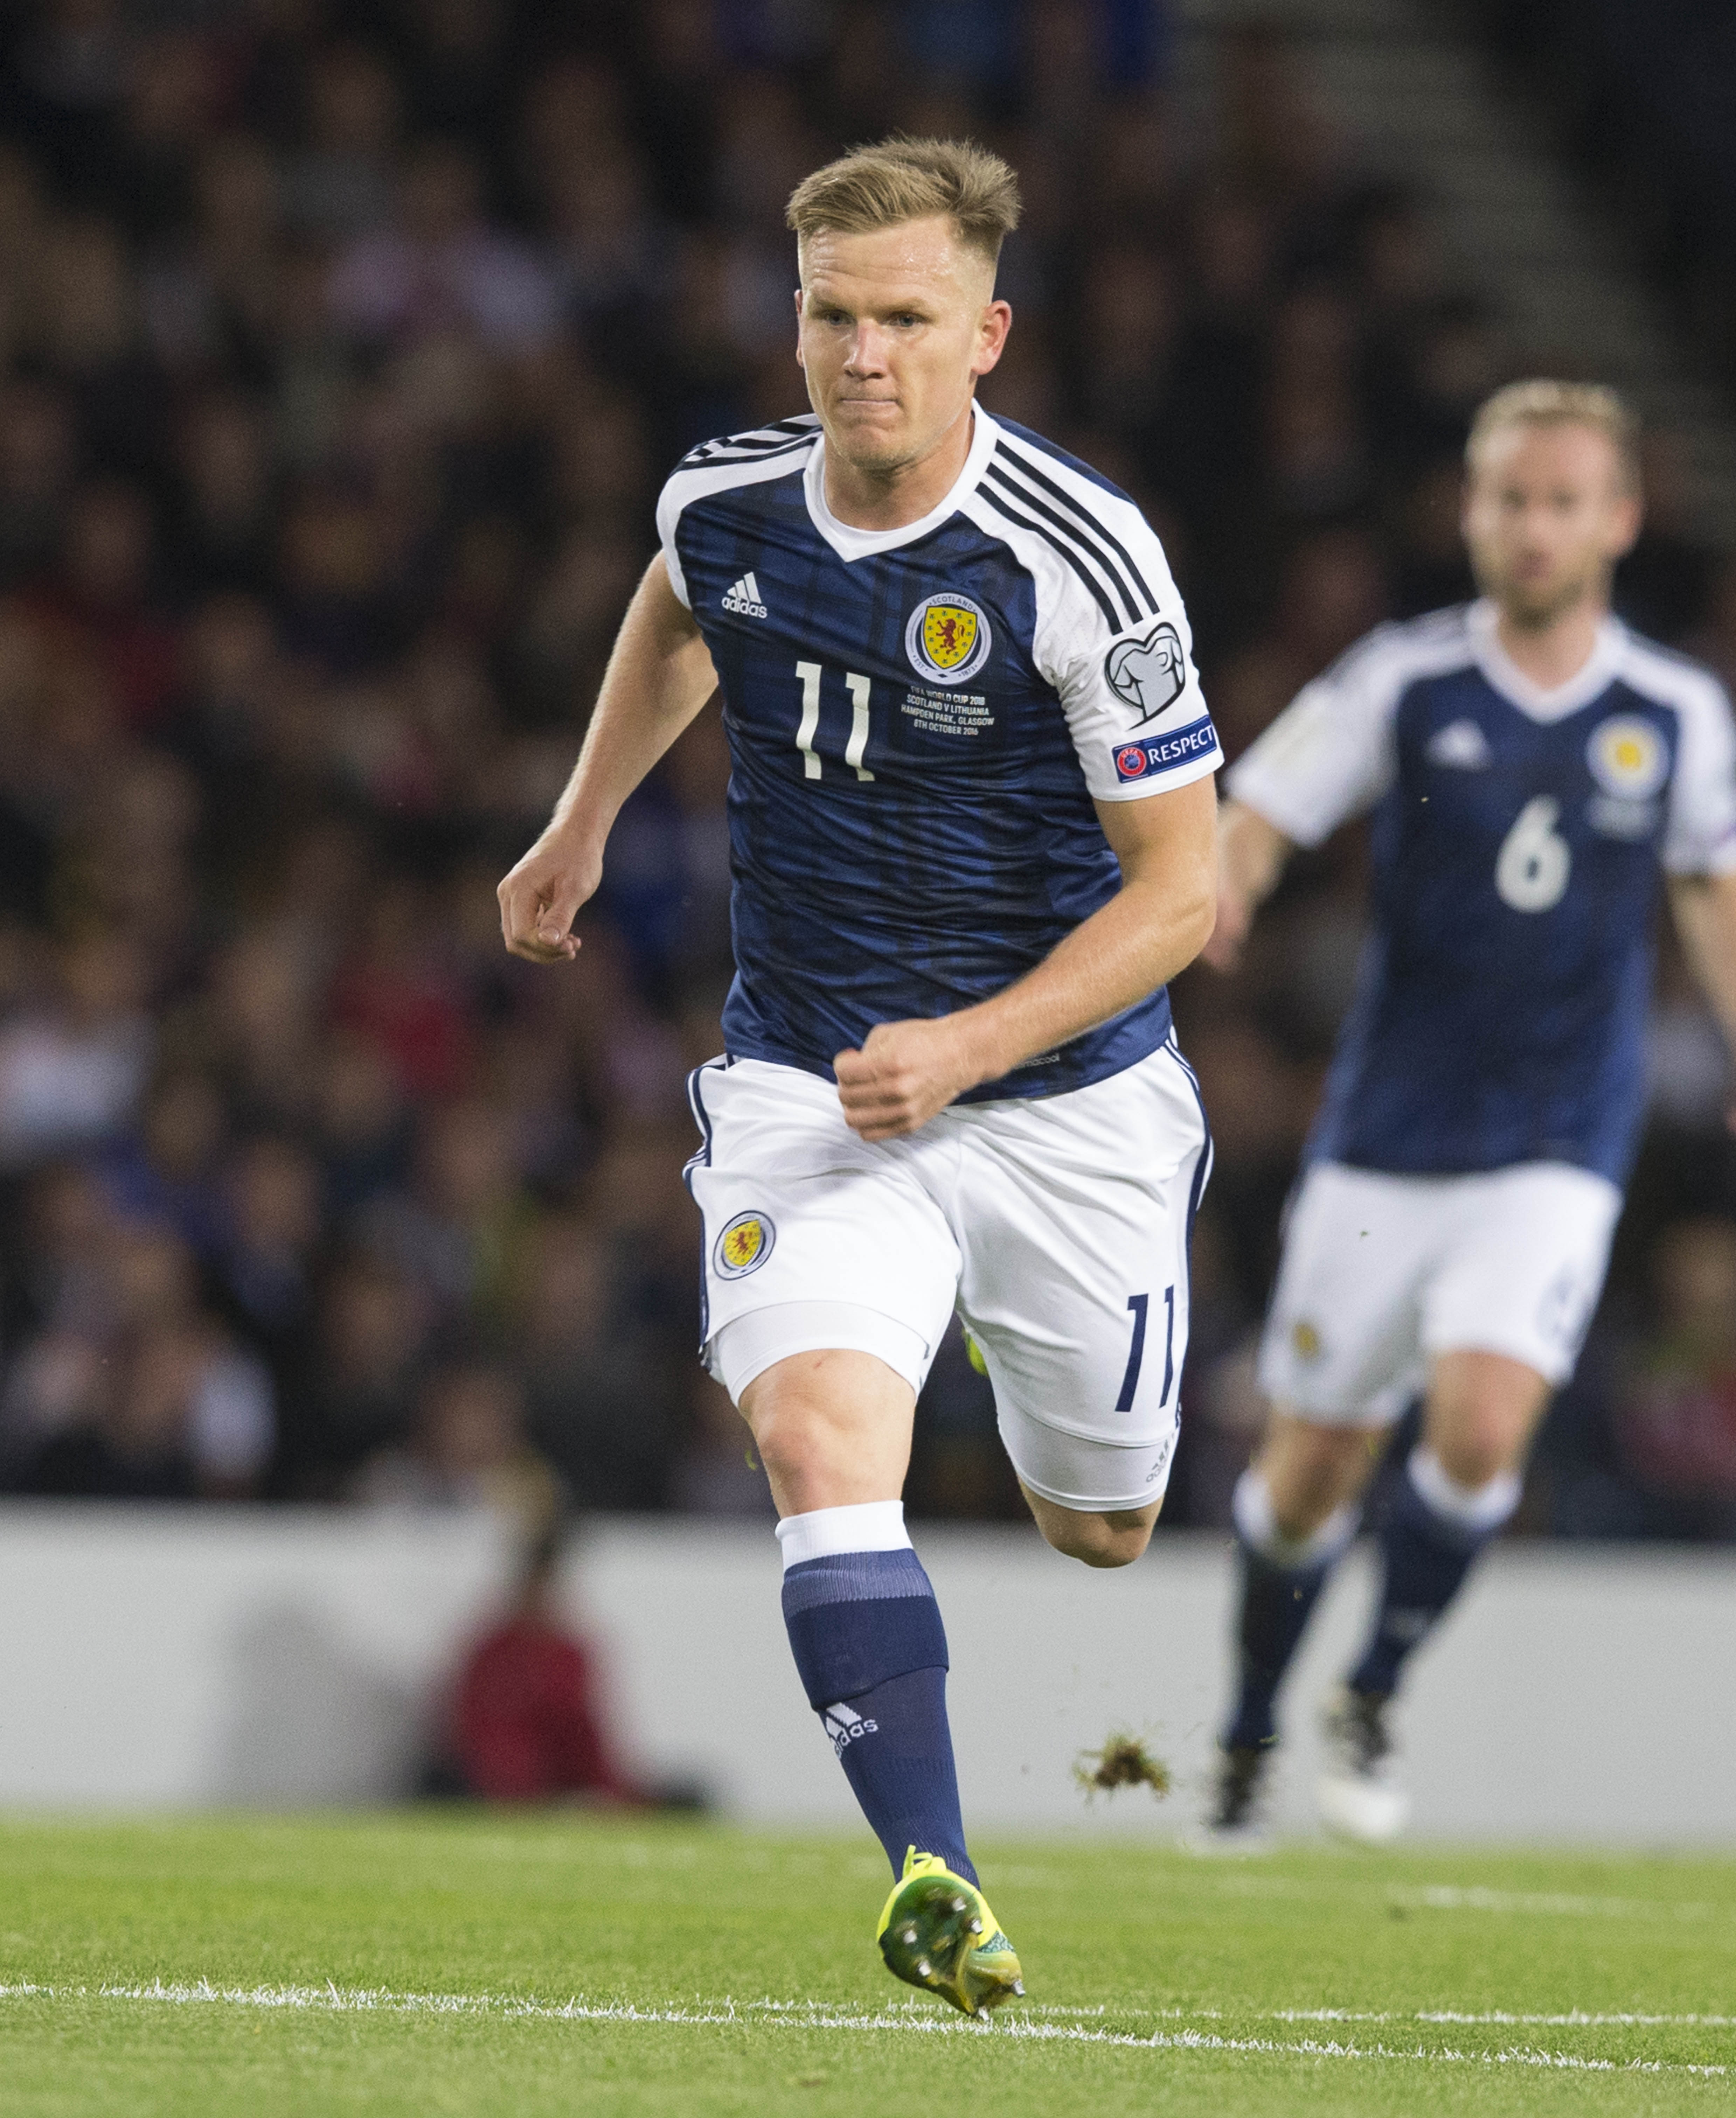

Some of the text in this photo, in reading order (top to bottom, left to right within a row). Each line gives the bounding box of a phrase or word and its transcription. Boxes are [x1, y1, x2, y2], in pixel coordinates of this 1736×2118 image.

[721, 597, 768, 619] adidas
[932, 596, 973, 609] SCOTLAND
[961, 667, 975, 676] 1873
[907, 694, 989, 715] SCOTLAND V LITHUANIA
[926, 689, 951, 701] WORLD
[953, 694, 968, 704] CUP
[796, 661, 875, 781] 11
[901, 704, 994, 725] HAMPDEN PARK, GLASGOW
[914, 719, 979, 736] 8TH OCTOBER 2016
[1148, 725, 1213, 765] RESPECT
[1494, 794, 1571, 914] 6
[1115, 1285, 1174, 1412] 11
